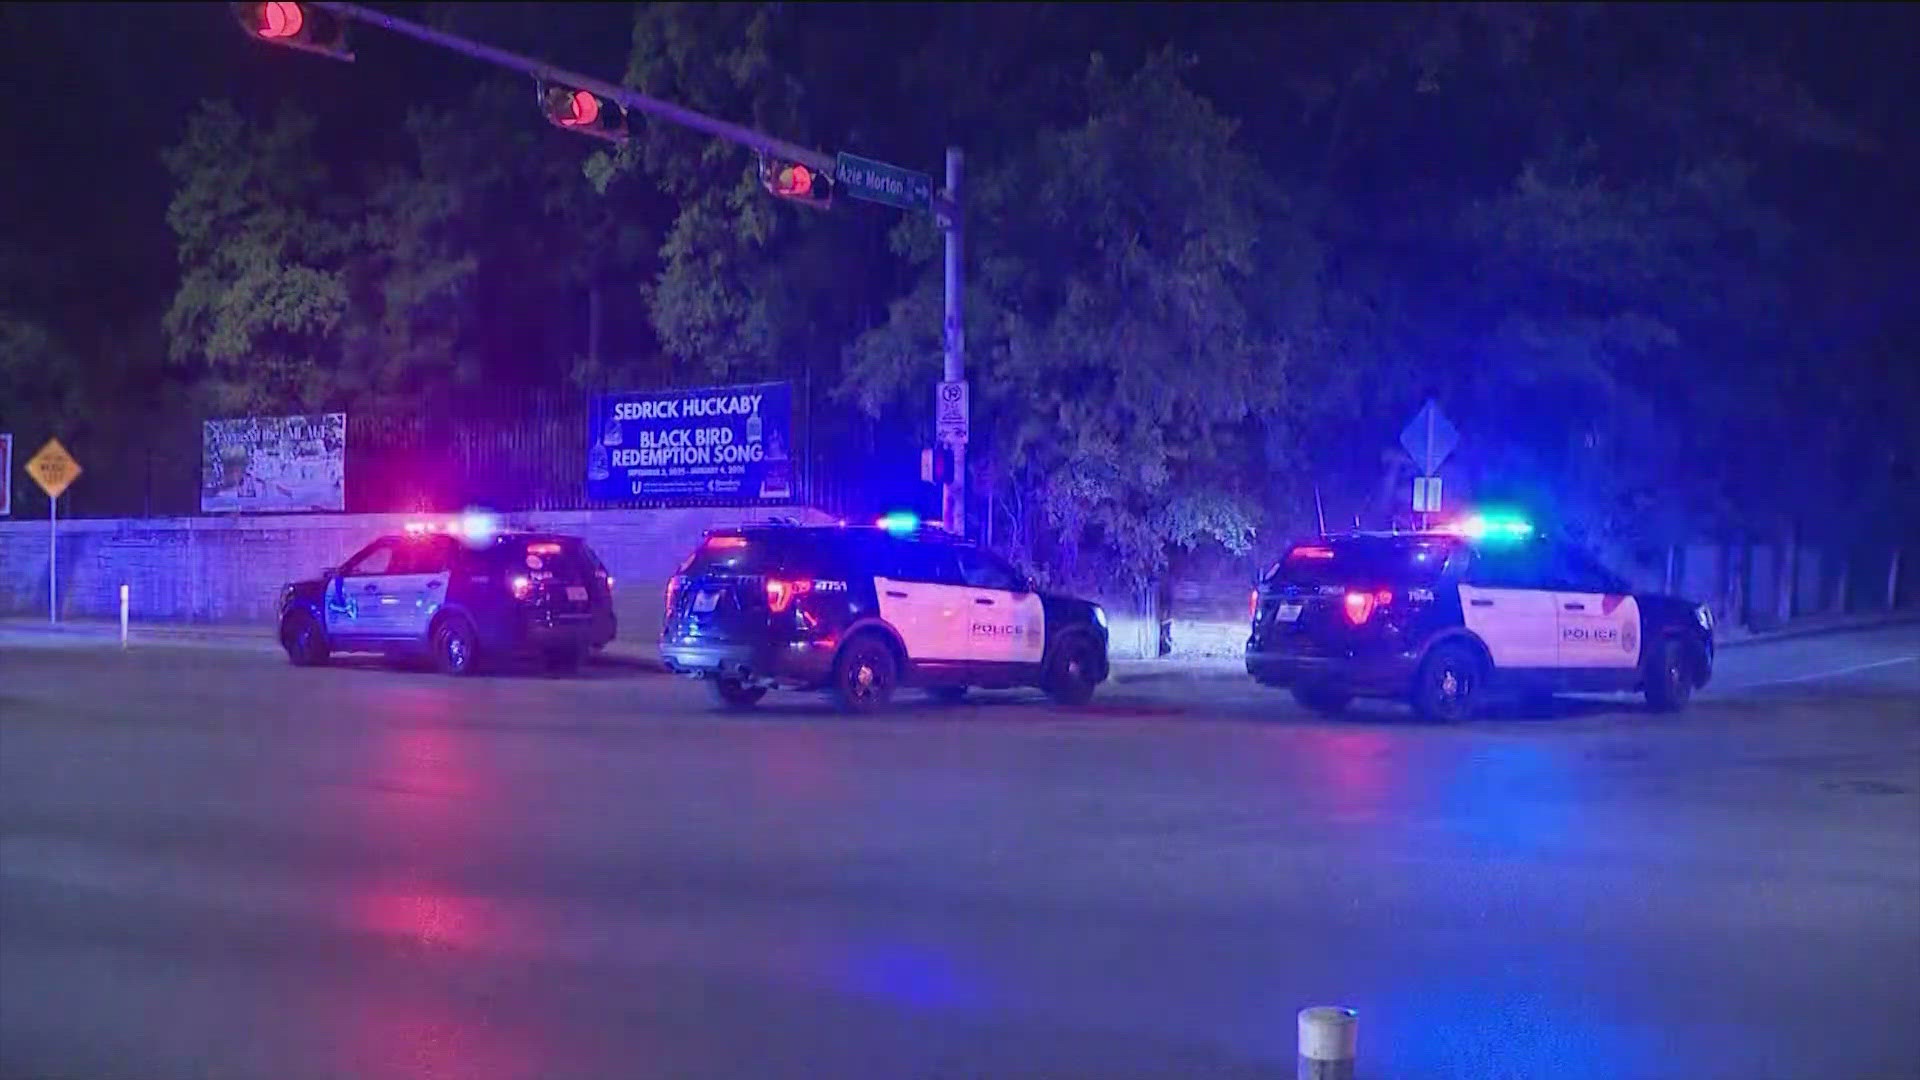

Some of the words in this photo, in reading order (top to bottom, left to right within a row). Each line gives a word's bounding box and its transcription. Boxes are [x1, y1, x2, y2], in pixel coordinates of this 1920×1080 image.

[839, 164, 862, 186] Azie
[866, 170, 903, 194] Morton
[614, 402, 679, 420] SEDRICK
[683, 395, 762, 417] HUCKABY
[640, 429, 691, 448] BLACK
[695, 427, 733, 446] BIRD
[612, 447, 710, 467] REDEMPTION
[713, 444, 764, 463] SONG
[972, 623, 1023, 635] POLICE
[1563, 629, 1617, 640] POLICE
